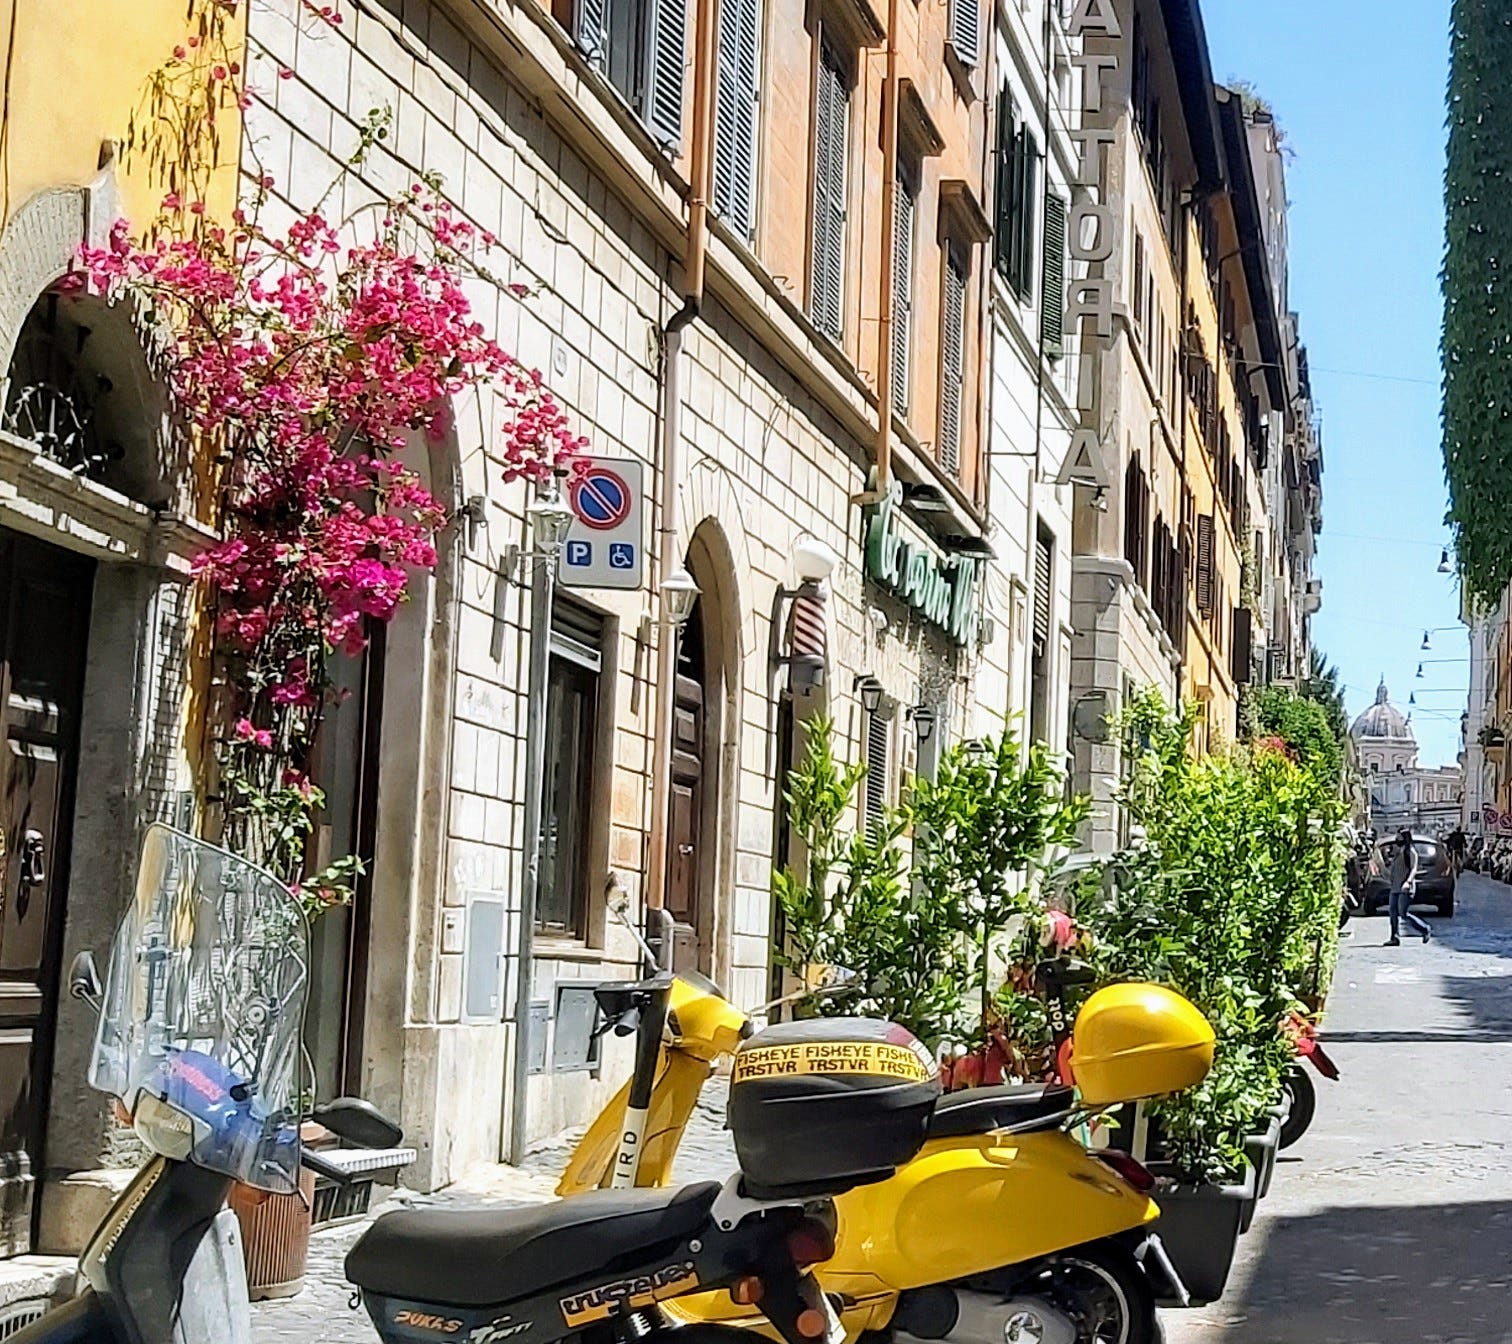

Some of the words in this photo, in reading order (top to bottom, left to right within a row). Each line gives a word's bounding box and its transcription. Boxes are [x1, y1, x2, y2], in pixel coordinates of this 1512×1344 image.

[572, 543, 588, 563] P
[1048, 997, 1065, 1032] dott
[737, 1047, 800, 1066] FISHEYE
[806, 1046, 872, 1058] FISHEYE
[739, 1060, 797, 1079] TRSTVR
[808, 1059, 868, 1071] TRSTVR
[613, 1131, 637, 1189] IRD
